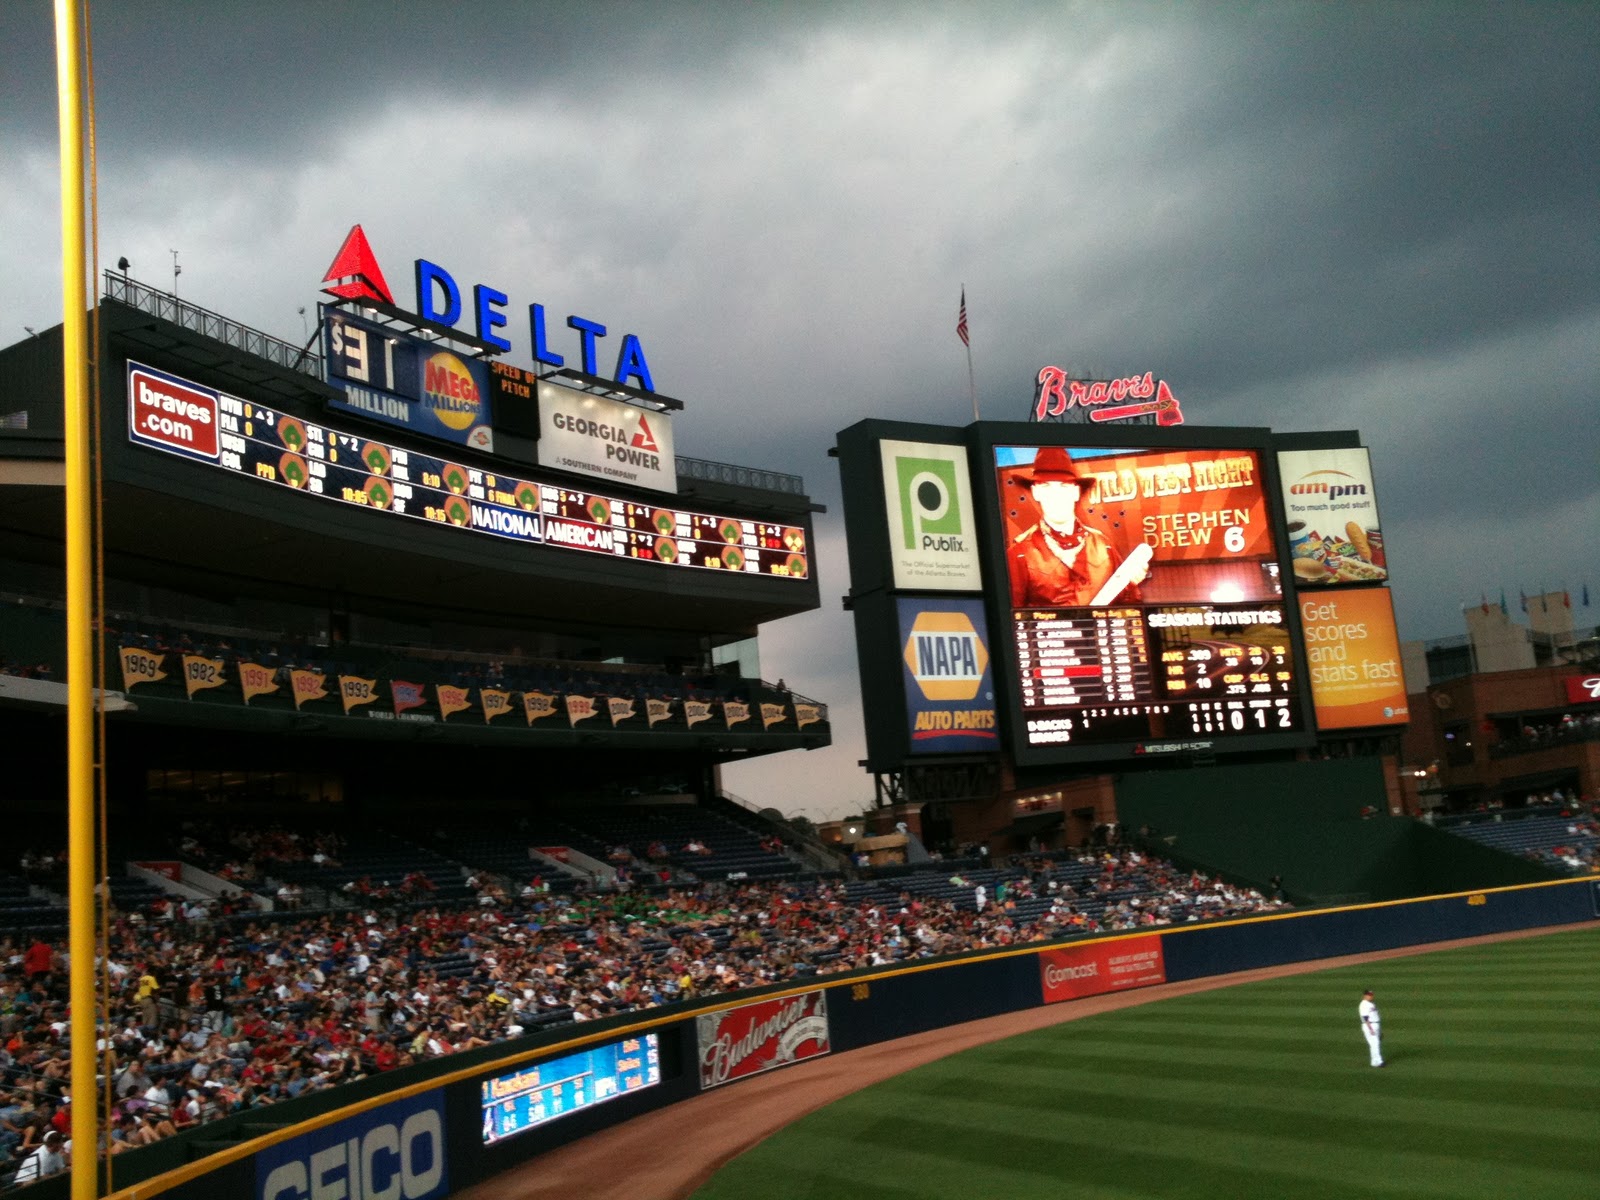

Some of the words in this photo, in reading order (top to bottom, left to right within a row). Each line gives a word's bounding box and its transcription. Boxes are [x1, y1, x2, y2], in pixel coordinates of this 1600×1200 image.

[415, 259, 655, 393] DELTA
[424, 358, 481, 403] MEGA
[491, 360, 520, 379] SPEED
[525, 372, 536, 384] OF
[501, 379, 530, 398] PITCH
[1036, 365, 1154, 422] Braves
[139, 382, 211, 425] braves
[345, 385, 409, 422] MILLION
[424, 392, 480, 414] MILLIONS
[141, 413, 193, 442] .com
[266, 411, 274, 426] 3
[553, 412, 627, 445] GEORGIA
[307, 425, 324, 442] STL
[351, 438, 358, 452] 2
[606, 443, 661, 471] POWER
[256, 462, 275, 480] PPD
[562, 457, 602, 474] SOUTHERN
[603, 466, 638, 481] COMPANY
[1083, 465, 1138, 505] WILD
[1137, 461, 1193, 499] WEST
[1194, 455, 1254, 493] NIGHT
[342, 487, 368, 505] 10:05
[488, 489, 495, 502] 6
[495, 491, 516, 507] FINAL
[559, 490, 566, 502] 5
[577, 494, 584, 506] 2
[1290, 482, 1366, 500] ampm
[561, 505, 567, 517] 1
[644, 507, 649, 518] 1
[1290, 504, 1305, 512] Too
[1330, 502, 1350, 511] good
[471, 505, 542, 538] NATIONAL
[1142, 508, 1250, 534] STEPHEN
[545, 520, 613, 550] AMERICAN
[630, 533, 637, 544] 2
[922, 535, 964, 552] Publix
[1144, 528, 1212, 549] DREW
[1223, 526, 1245, 553] 6
[1148, 612, 1204, 628] SEASON
[1204, 610, 1282, 626] STATISTICS
[1301, 601, 1339, 622] Get
[1305, 622, 1368, 643] scores
[917, 636, 977, 676] NAPA
[1161, 651, 1184, 662] AVG
[1219, 647, 1243, 657] HITS
[1276, 656, 1284, 664] 3
[1309, 640, 1347, 662] and
[124, 654, 156, 678] 1969
[186, 661, 215, 683] 1982
[1167, 665, 1184, 675] HR
[1197, 663, 1207, 674] 2
[1312, 662, 1358, 684] stats
[1361, 658, 1399, 680] fast
[244, 668, 268, 688] 1991
[295, 675, 319, 695] 1992
[1250, 673, 1270, 682] SLG
[1281, 682, 1288, 691] 1
[343, 681, 369, 698] 1993
[914, 710, 952, 731] AUTO
[953, 709, 996, 729] PARTS
[1082, 718, 1089, 728] 1
[1231, 710, 1244, 730] 0
[1255, 709, 1266, 728] 1
[1278, 708, 1291, 727] 2
[1091, 709, 1097, 717] 2
[1101, 709, 1107, 717] 3
[1113, 708, 1120, 716] 4
[1122, 708, 1129, 716] 5
[1132, 707, 1138, 715] 6
[1145, 706, 1151, 714] 7
[1154, 706, 1160, 714] 8
[1163, 705, 1169, 713] 9
[1192, 723, 1200, 732] 0
[1205, 722, 1212, 732] 0
[1218, 721, 1224, 731] 1
[1144, 744, 1181, 753] MITSUBISHI
[704, 994, 809, 1084] Budweiser
[263, 1109, 443, 1200] GEICO
